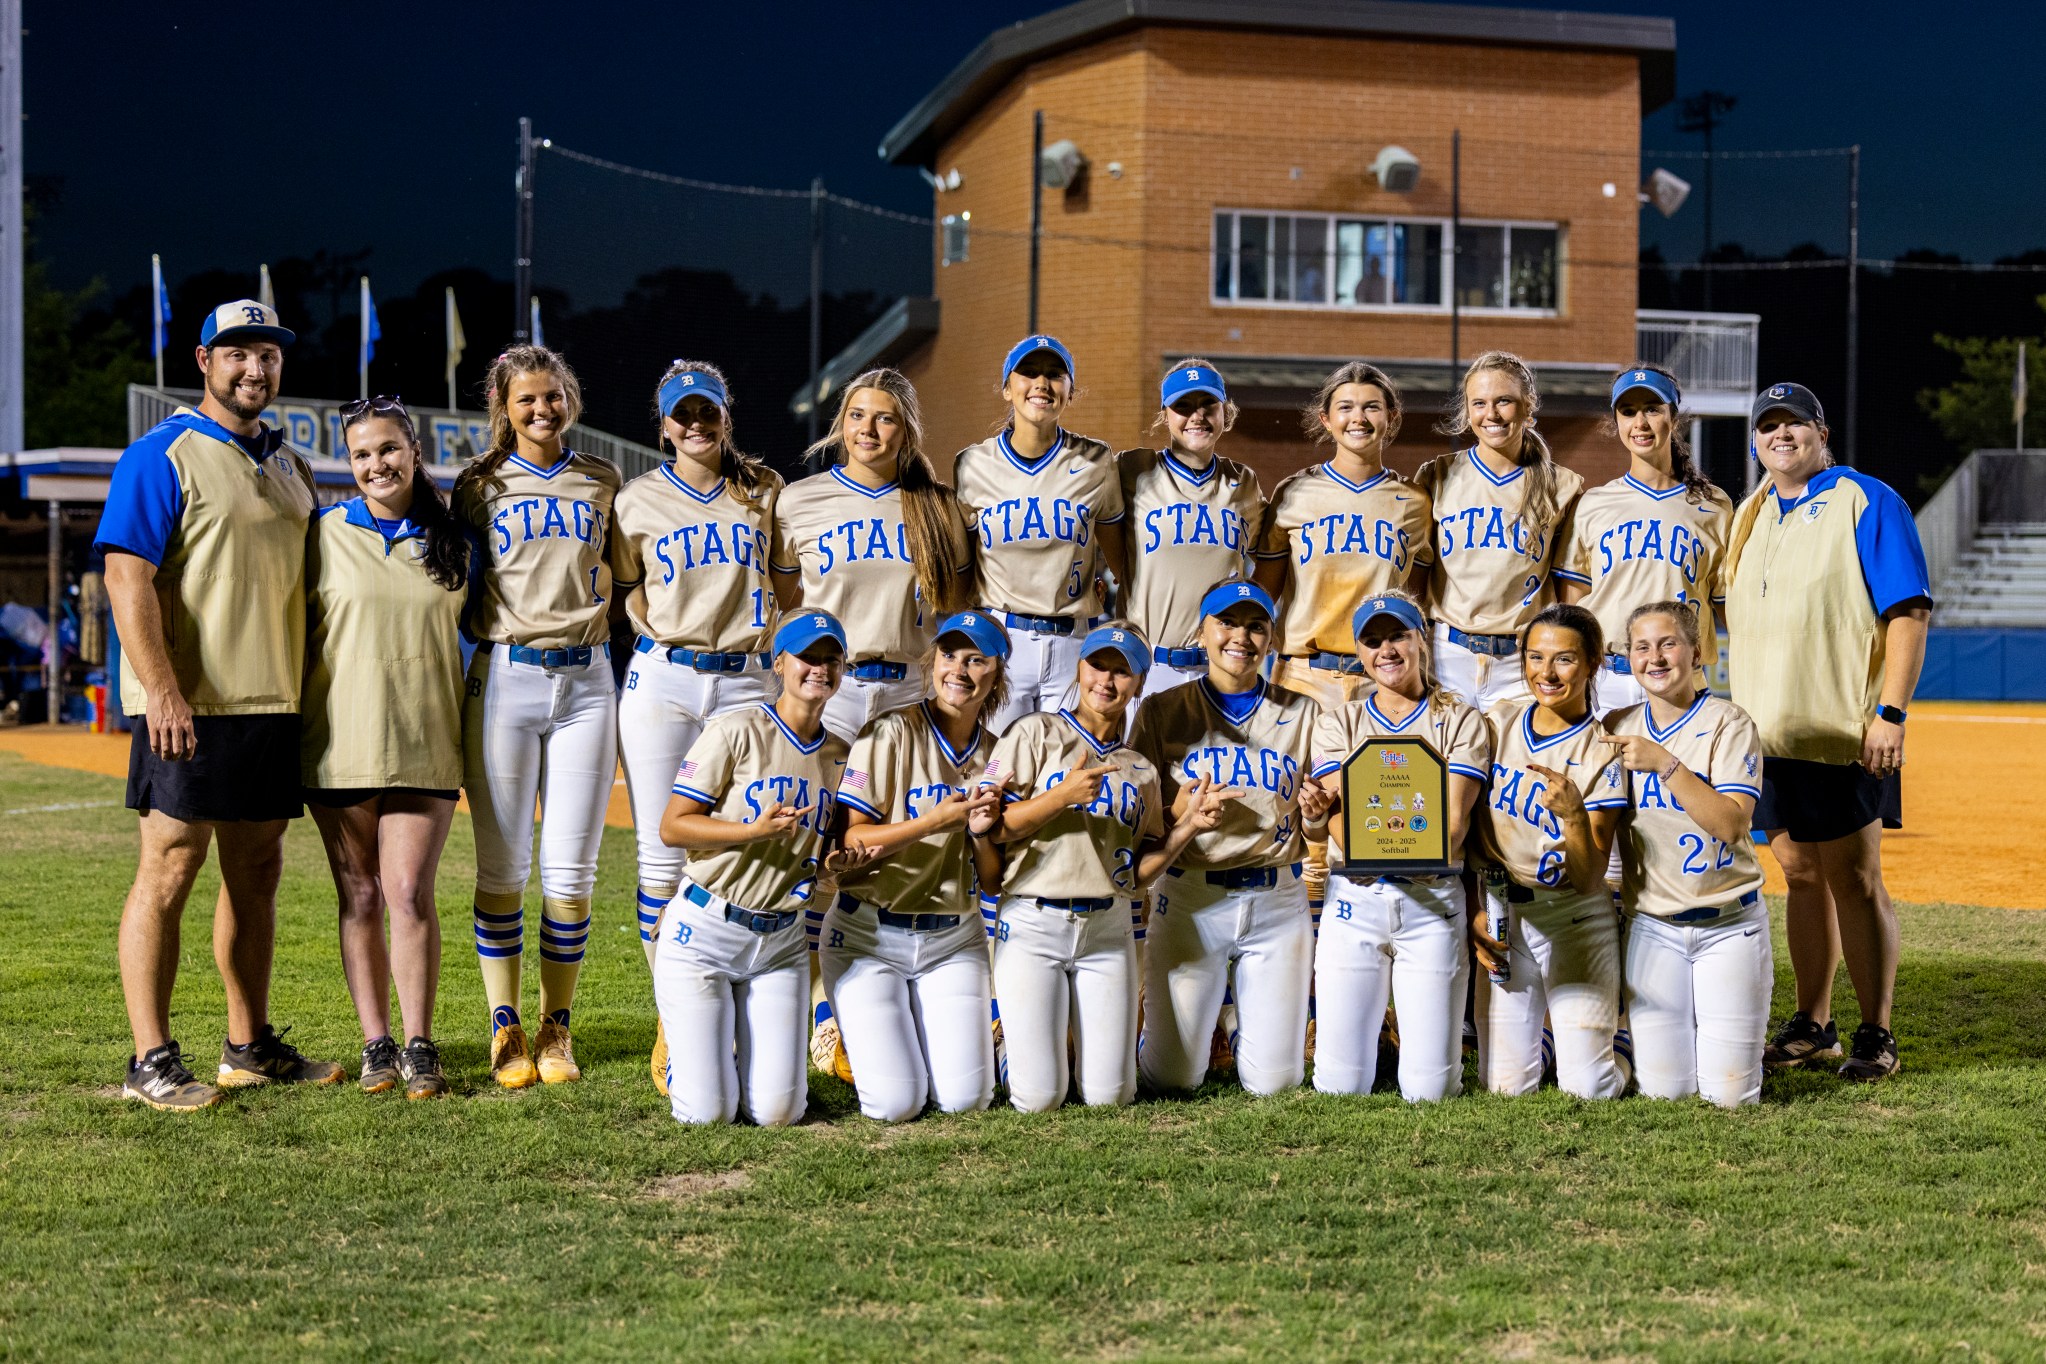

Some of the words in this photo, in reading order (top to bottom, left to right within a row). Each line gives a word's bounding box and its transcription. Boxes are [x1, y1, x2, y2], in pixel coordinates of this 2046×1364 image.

[242, 306, 265, 325] B
[493, 497, 605, 557] STAGS
[979, 496, 1091, 550] STAGS
[1144, 502, 1250, 560] STAGS
[1299, 512, 1410, 573] STAGS
[655, 520, 769, 587] STAGS
[1599, 518, 1705, 584] STAGS
[1066, 559, 1083, 598] 5
[1523, 574, 1542, 607] 2
[627, 670, 640, 690] B
[1181, 745, 1299, 801] STAGS
[742, 775, 834, 837] STAG
[1536, 850, 1564, 887] 6
[1678, 833, 1735, 876] 22
[673, 921, 693, 946] B
[1336, 899, 1352, 921] B
